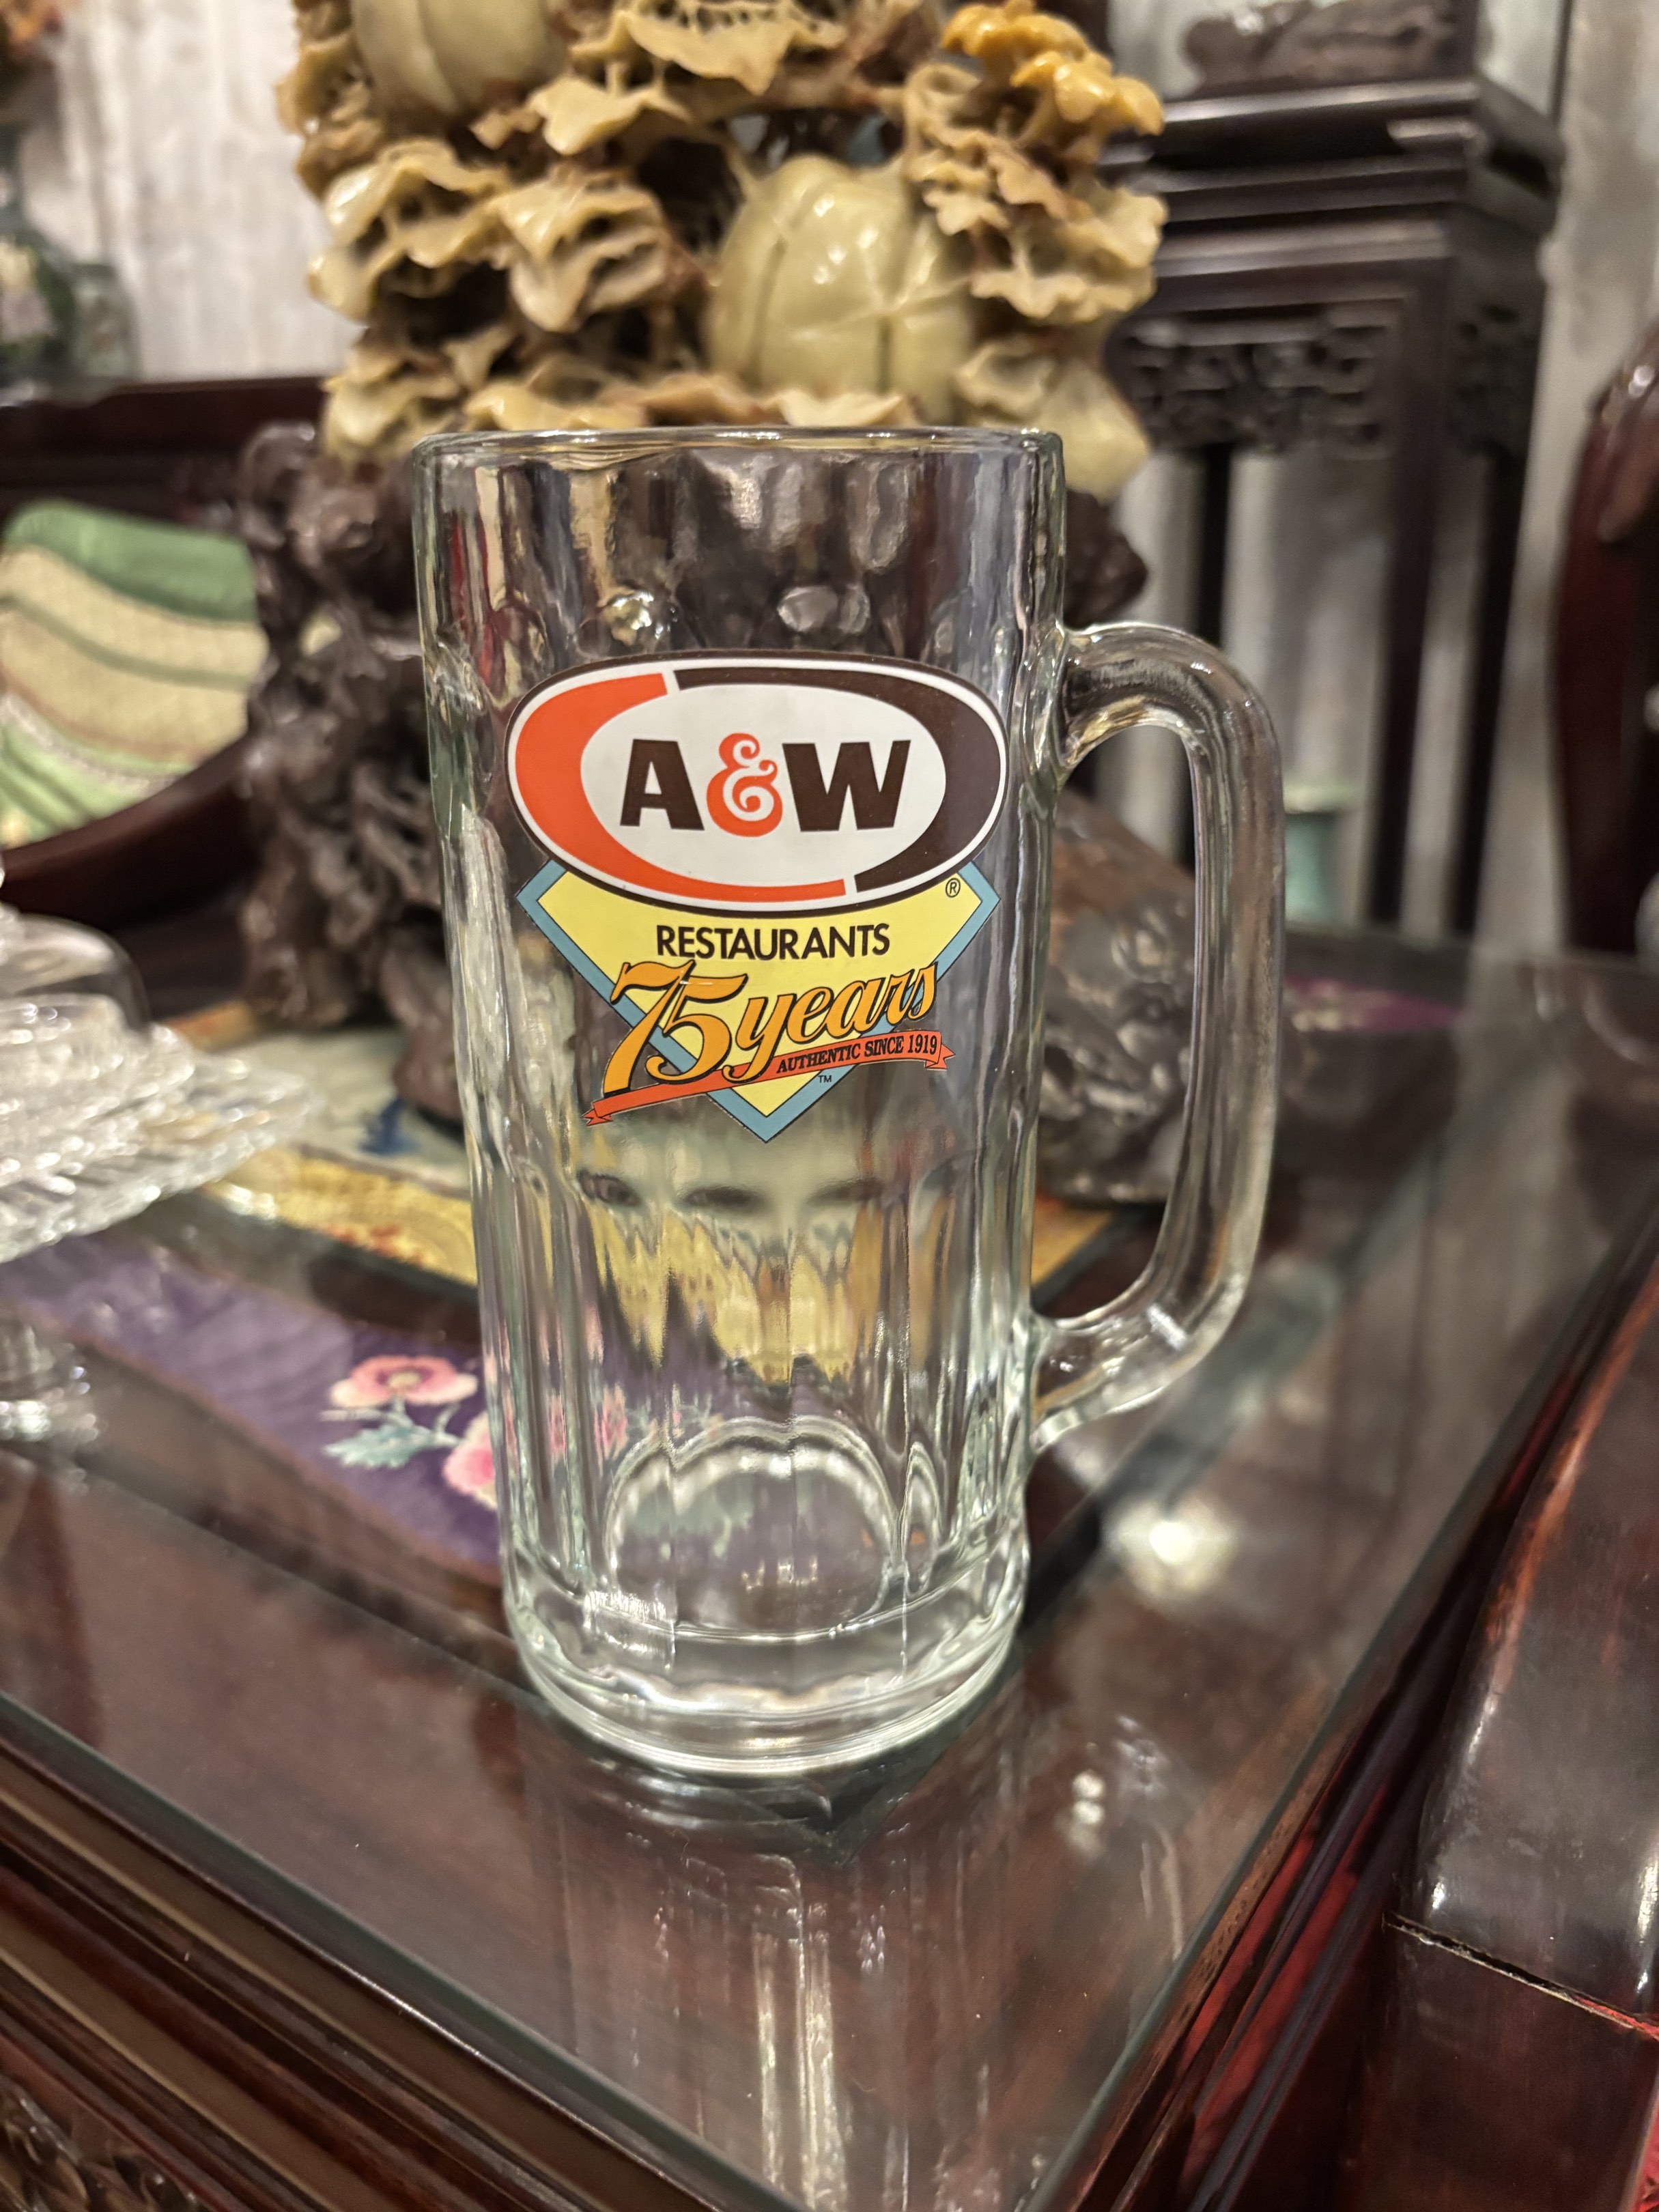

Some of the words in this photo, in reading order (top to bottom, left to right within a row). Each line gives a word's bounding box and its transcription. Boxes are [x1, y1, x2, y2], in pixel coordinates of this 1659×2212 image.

[620, 733, 911, 838] A&W
[657, 923, 890, 960] RESTAURANTS
[603, 960, 748, 1097] 75
[724, 961, 939, 1084] years
[776, 1043, 861, 1074] AUTHENTIC
[864, 1036, 904, 1058] SINCE
[907, 1035, 937, 1055] 1919
